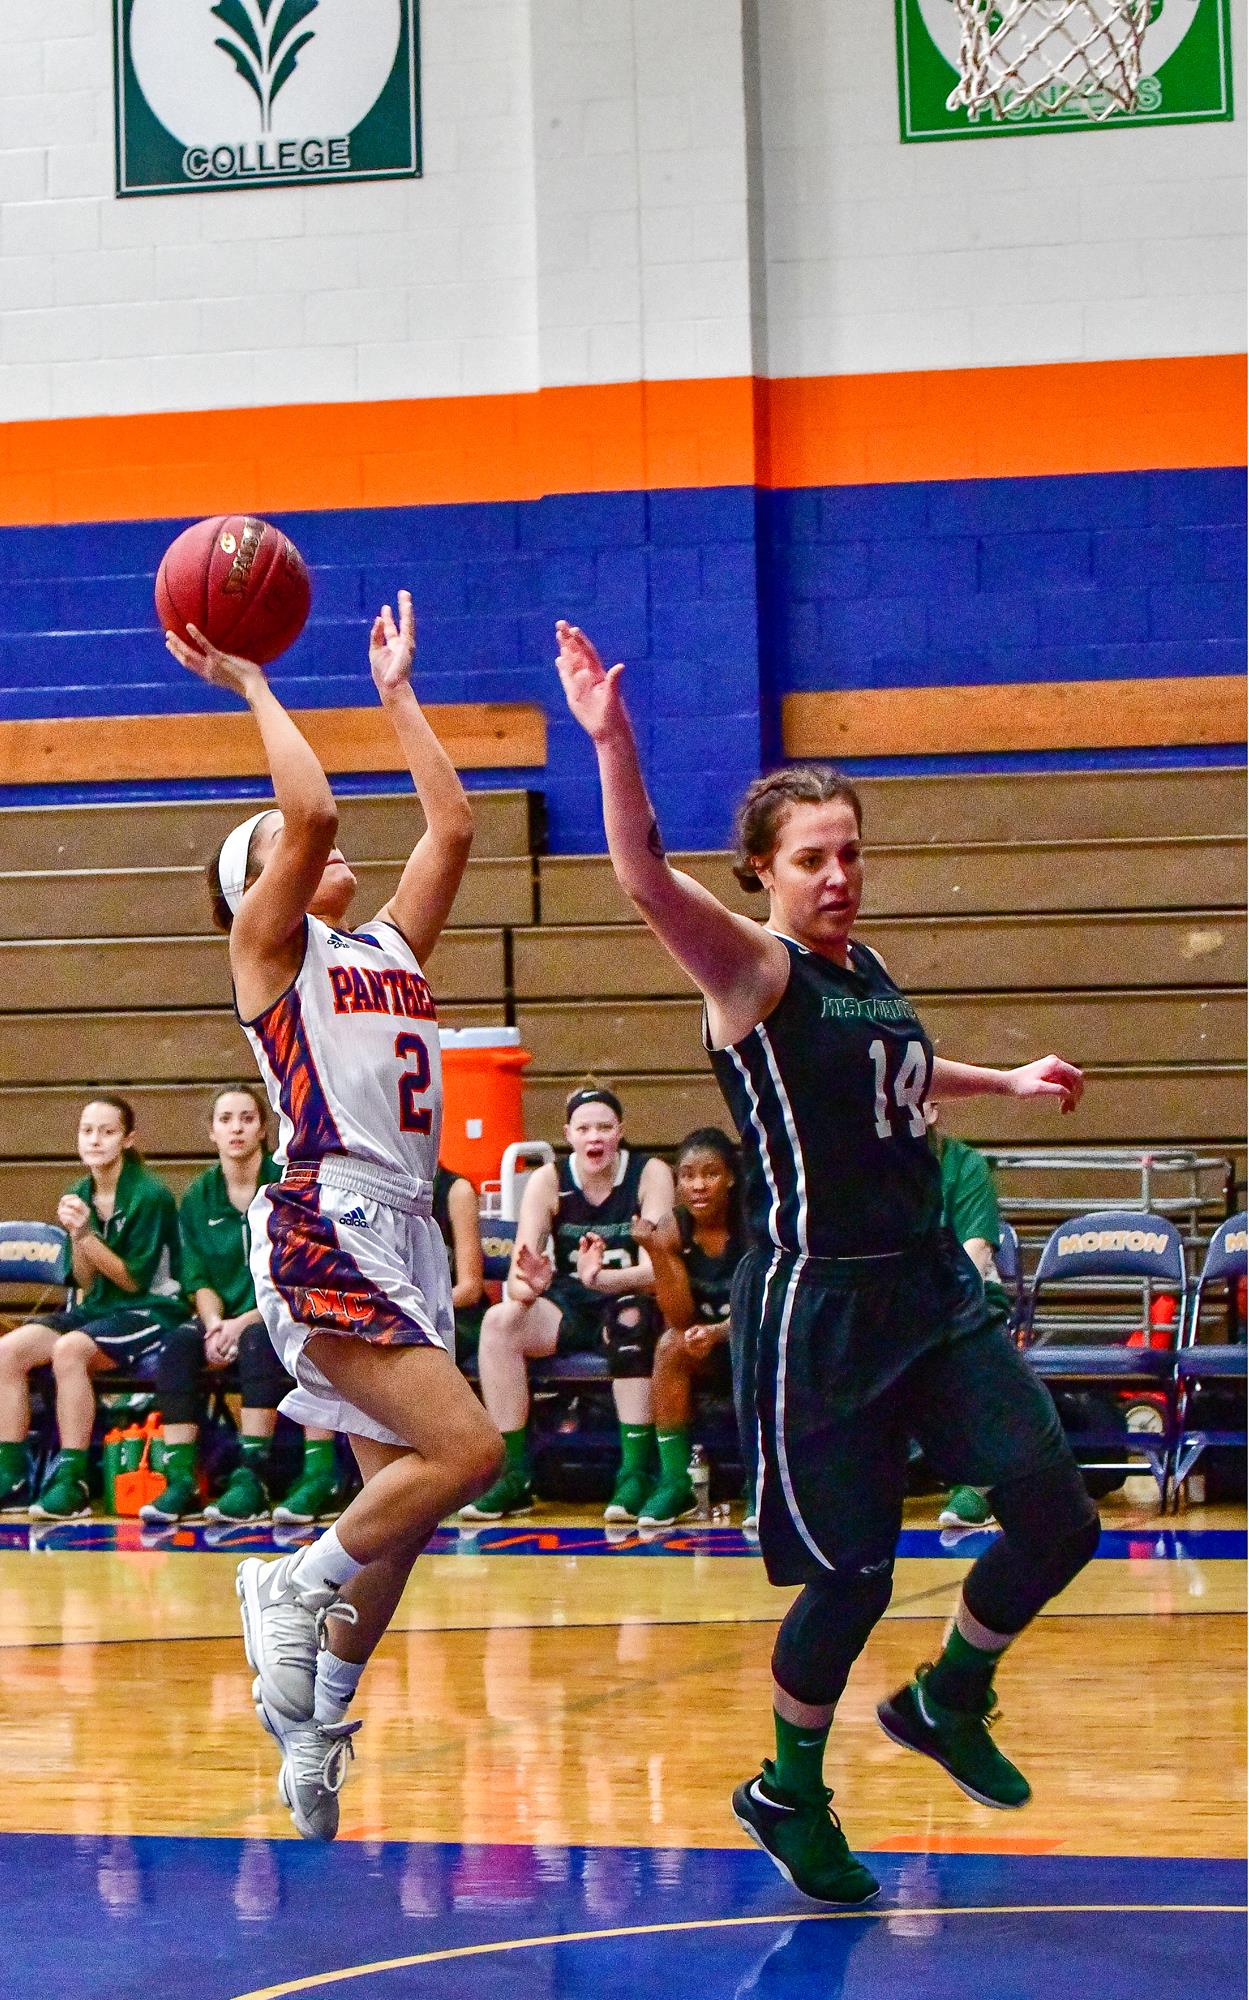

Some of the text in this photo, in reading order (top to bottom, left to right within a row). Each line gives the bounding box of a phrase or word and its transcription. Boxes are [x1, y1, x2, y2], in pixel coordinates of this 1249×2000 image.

[965, 77, 1162, 122] IONEES
[183, 136, 350, 179] COLLEGE
[394, 1031, 432, 1135] 2
[868, 1039, 927, 1139] 14
[1057, 1230, 1169, 1256] MORTON
[305, 1287, 376, 1321] MC
